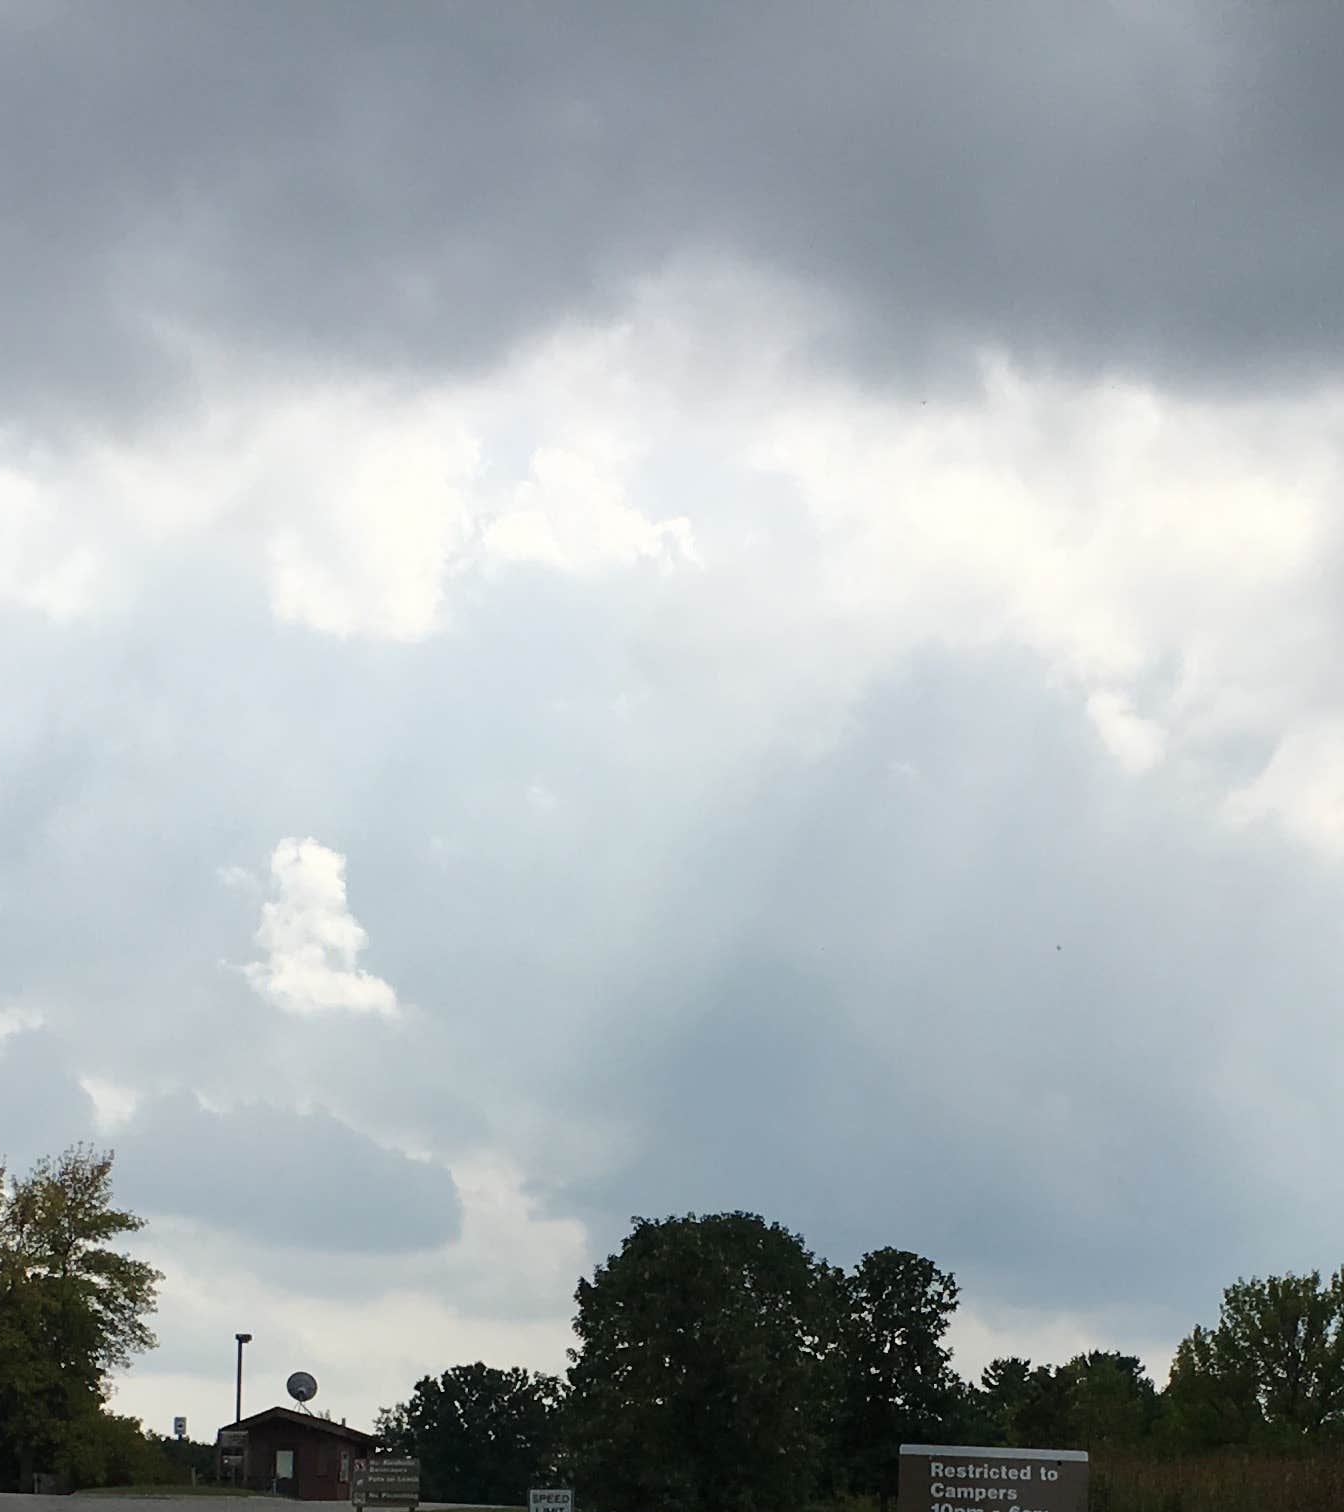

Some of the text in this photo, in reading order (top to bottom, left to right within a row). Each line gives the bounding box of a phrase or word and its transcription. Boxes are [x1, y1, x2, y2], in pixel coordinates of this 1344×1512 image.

[930, 1461, 1058, 1482] Restricted to
[532, 1494, 570, 1504] SPEED
[930, 1482, 1018, 1502] Campers
